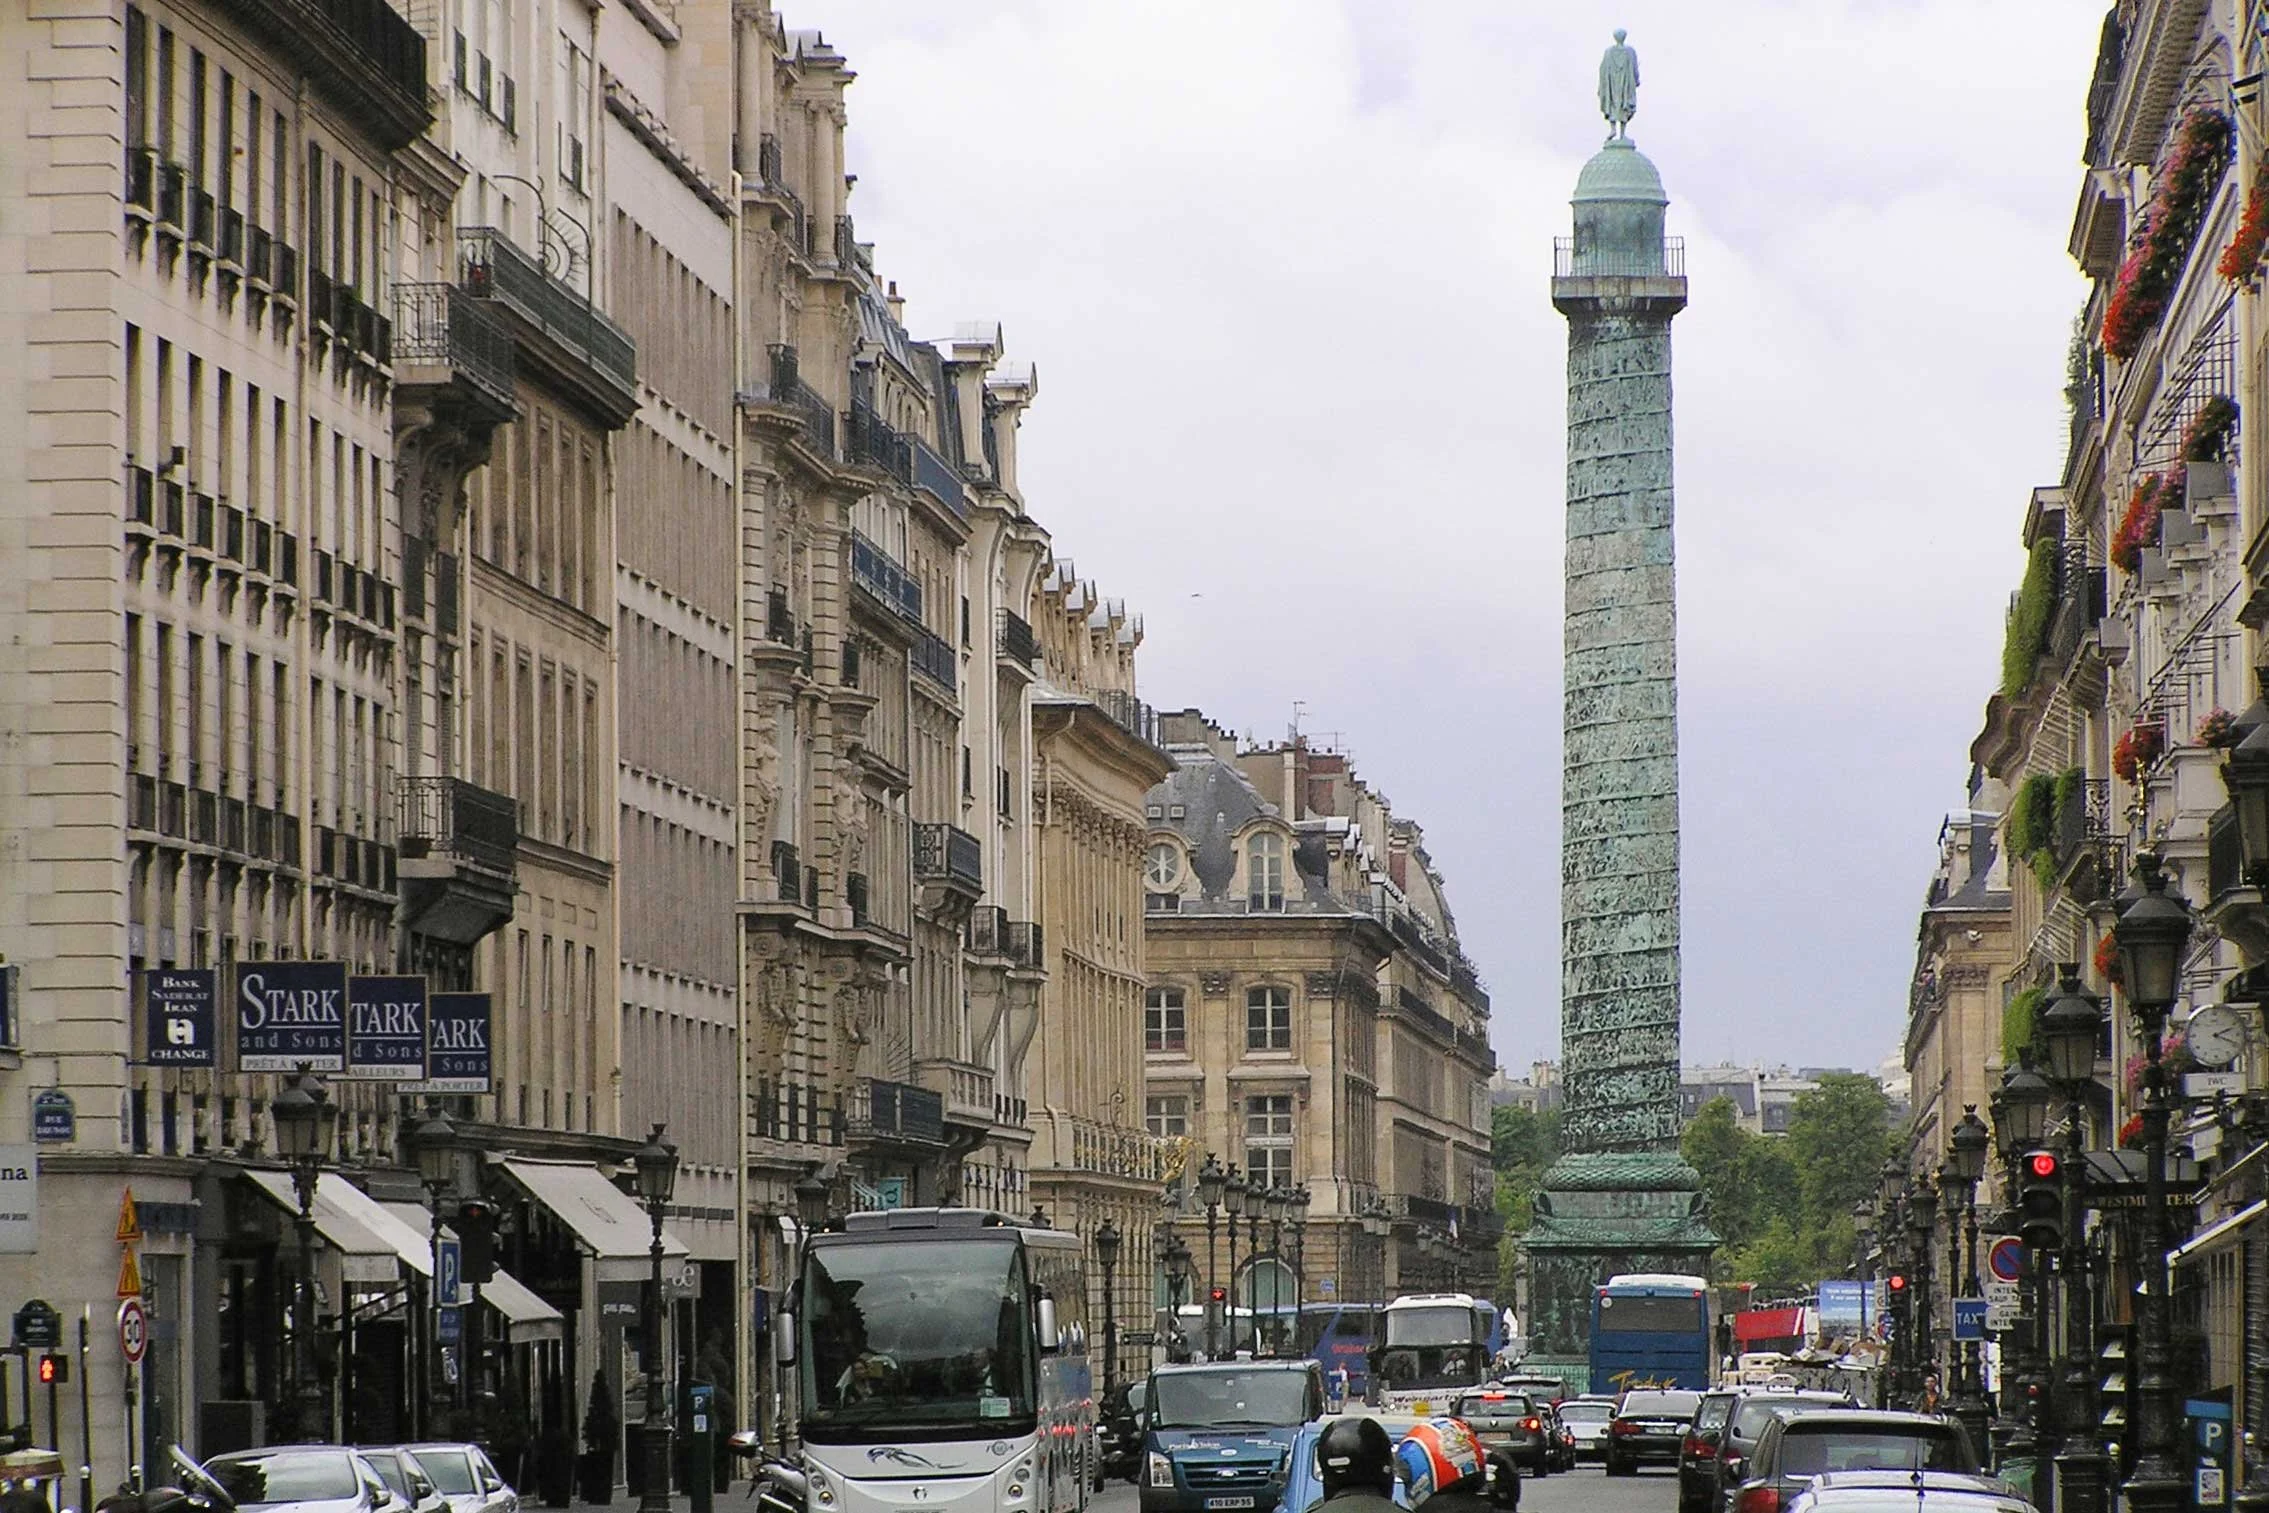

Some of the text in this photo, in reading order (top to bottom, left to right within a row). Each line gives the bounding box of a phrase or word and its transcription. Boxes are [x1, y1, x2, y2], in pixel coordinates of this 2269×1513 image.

[241, 973, 341, 1029] STARK
[351, 1003, 421, 1033] TARK
[241, 1032, 343, 1048] and Sons
[430, 1018, 486, 1048] ARK
[151, 1048, 209, 1060] CHANGE
[374, 1043, 422, 1058] Sons
[290, 1058, 338, 1069] PTER
[442, 1057, 488, 1072] Sons
[351, 1067, 406, 1077] AILLEURS
[2097, 1193, 2194, 1207] WESTMITER
[1956, 1312, 1985, 1325] TAX
[125, 1318, 140, 1344] 30
[2206, 1422, 2222, 1448] P
